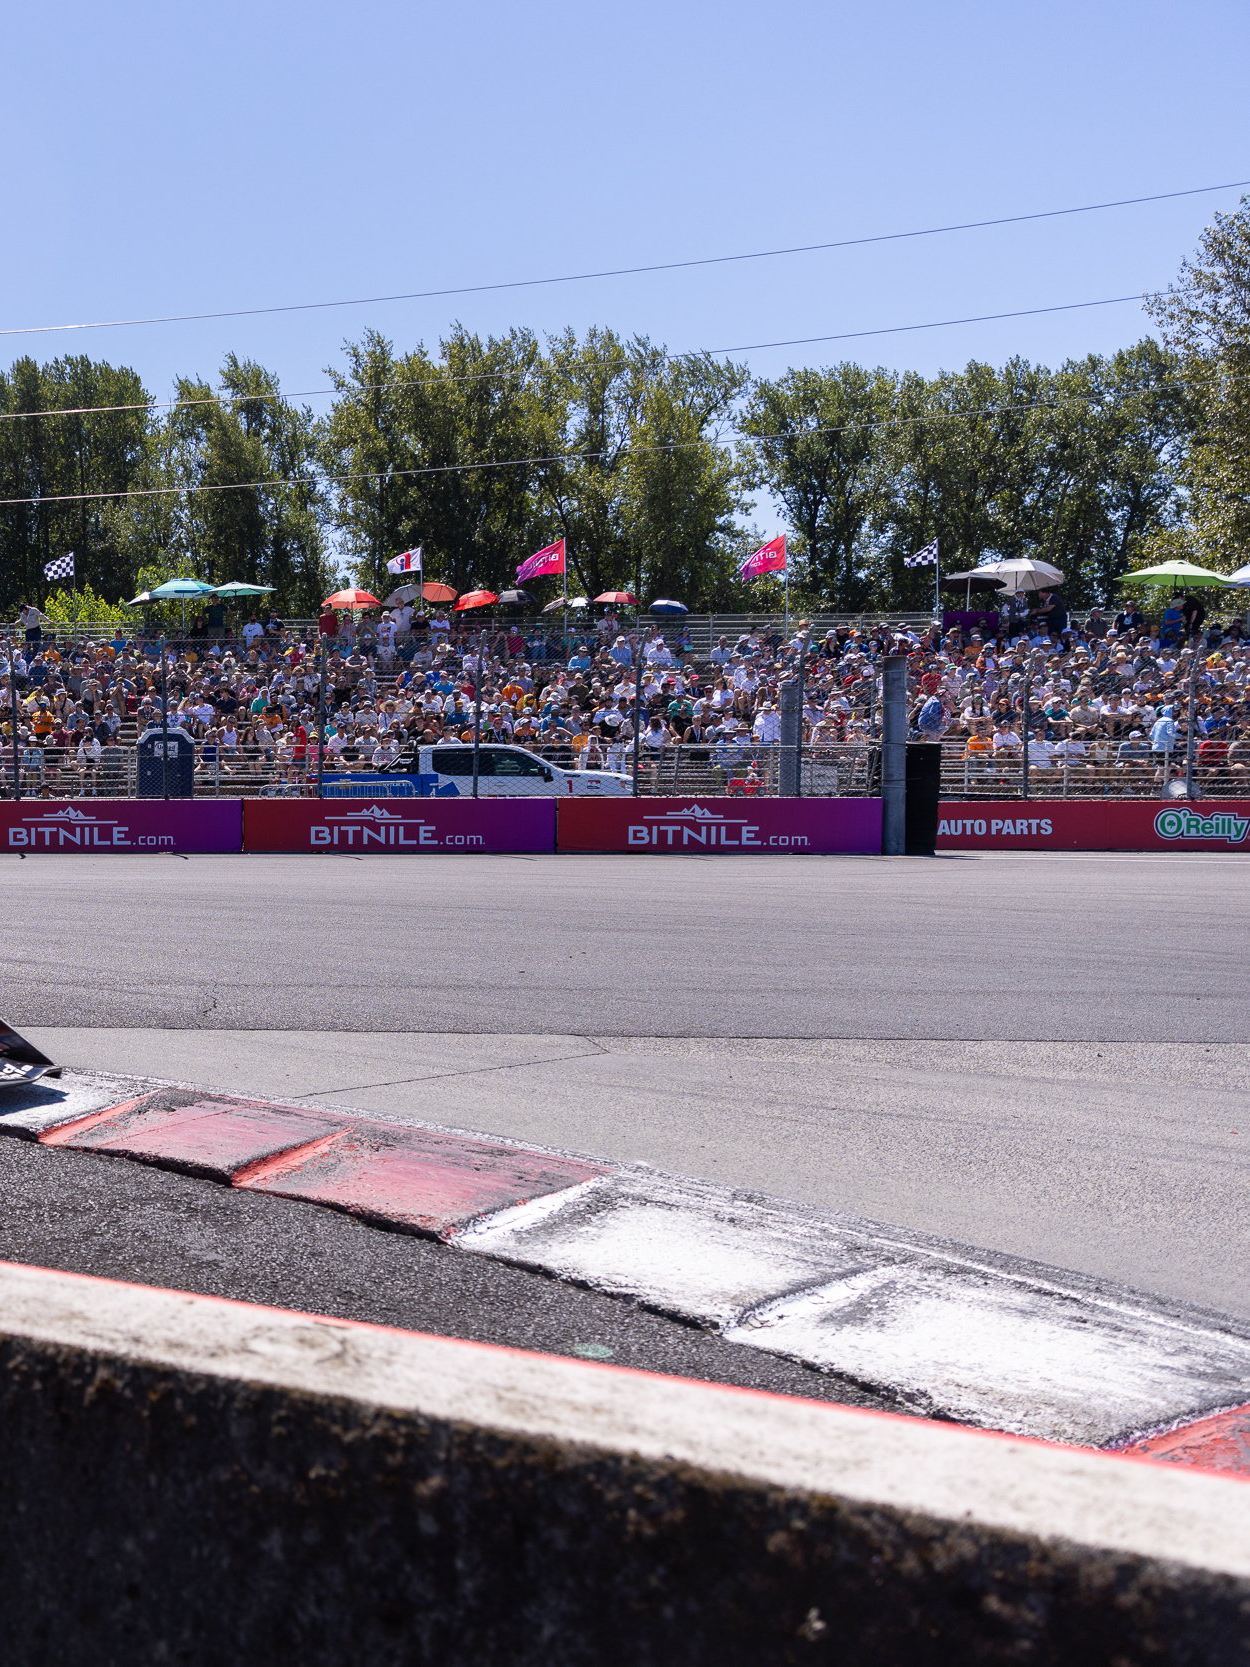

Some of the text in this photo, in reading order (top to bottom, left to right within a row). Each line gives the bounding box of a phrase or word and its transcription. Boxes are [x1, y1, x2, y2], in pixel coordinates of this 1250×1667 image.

[566, 780, 573, 793] 1
[310, 825, 483, 845] BITNILE.com
[937, 818, 1053, 835] AUTO PARTS
[1157, 810, 1248, 841] O'Reilly
[8, 827, 174, 846] BITNILE.com
[628, 825, 808, 846] BITNILE.com
